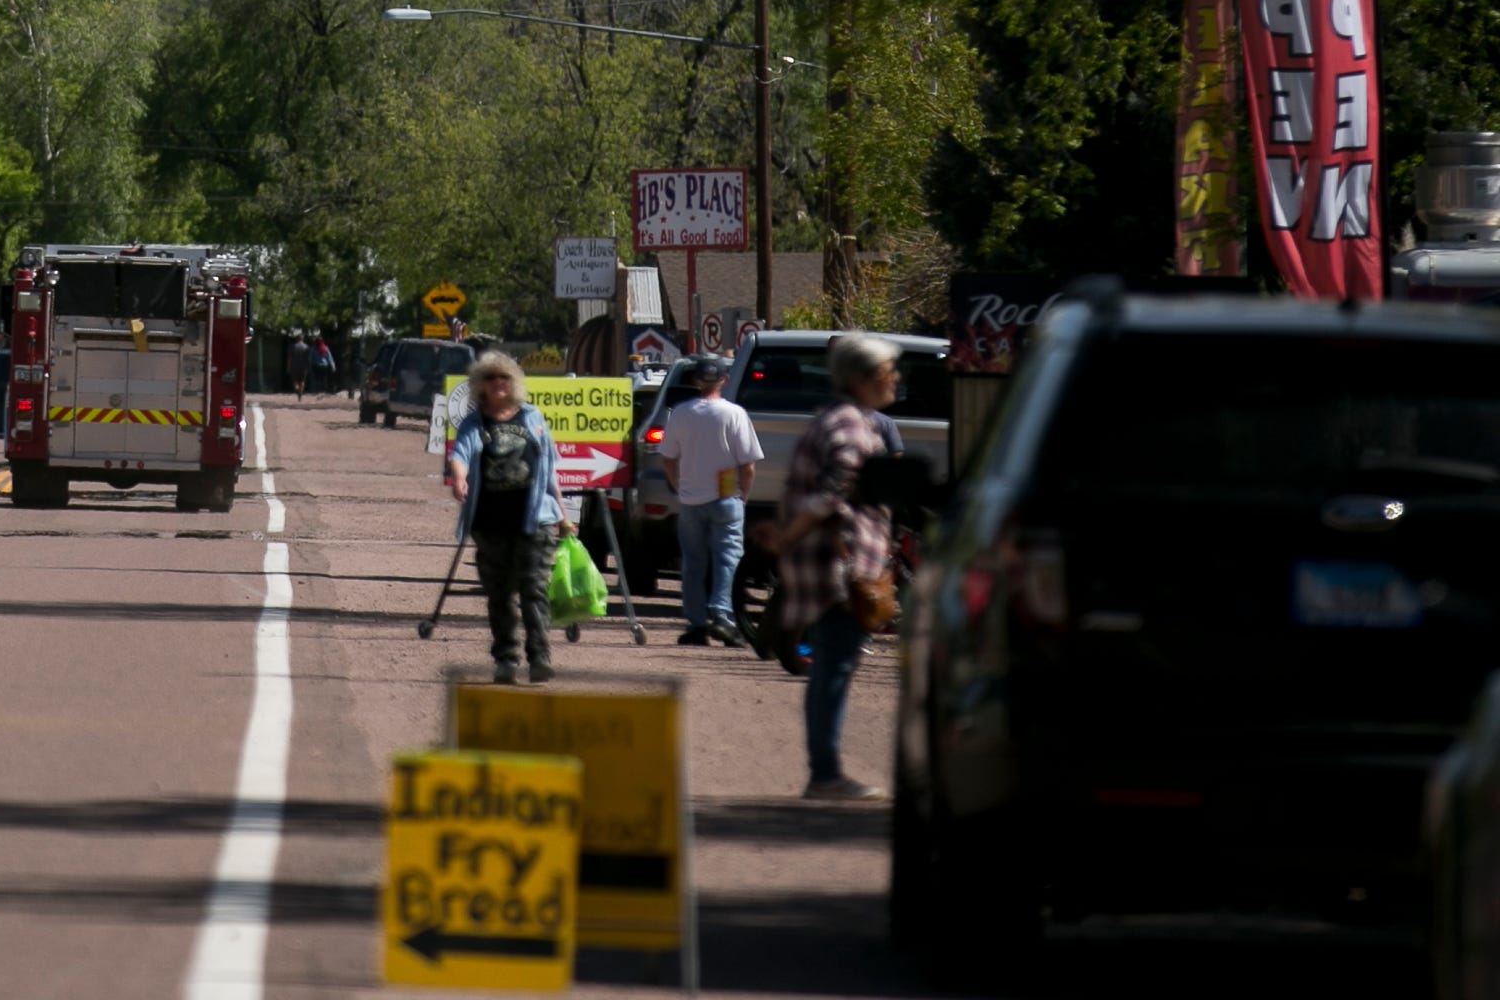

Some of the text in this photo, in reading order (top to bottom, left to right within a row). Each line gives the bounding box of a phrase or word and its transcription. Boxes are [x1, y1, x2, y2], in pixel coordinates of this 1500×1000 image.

[686, 174, 742, 222] PLACE
[660, 229, 674, 245] All
[680, 229, 707, 245] Good
[557, 239, 584, 260] Coach
[564, 259, 610, 271] Antiques
[564, 283, 612, 297] Boutique
[526, 388, 632, 407] graved Gifts
[544, 413, 627, 432] bin Decor
[560, 443, 576, 454] Art
[558, 473, 588, 484] himes
[394, 758, 580, 828] Indian
[435, 832, 544, 887] Fry
[396, 868, 564, 930] Bread
